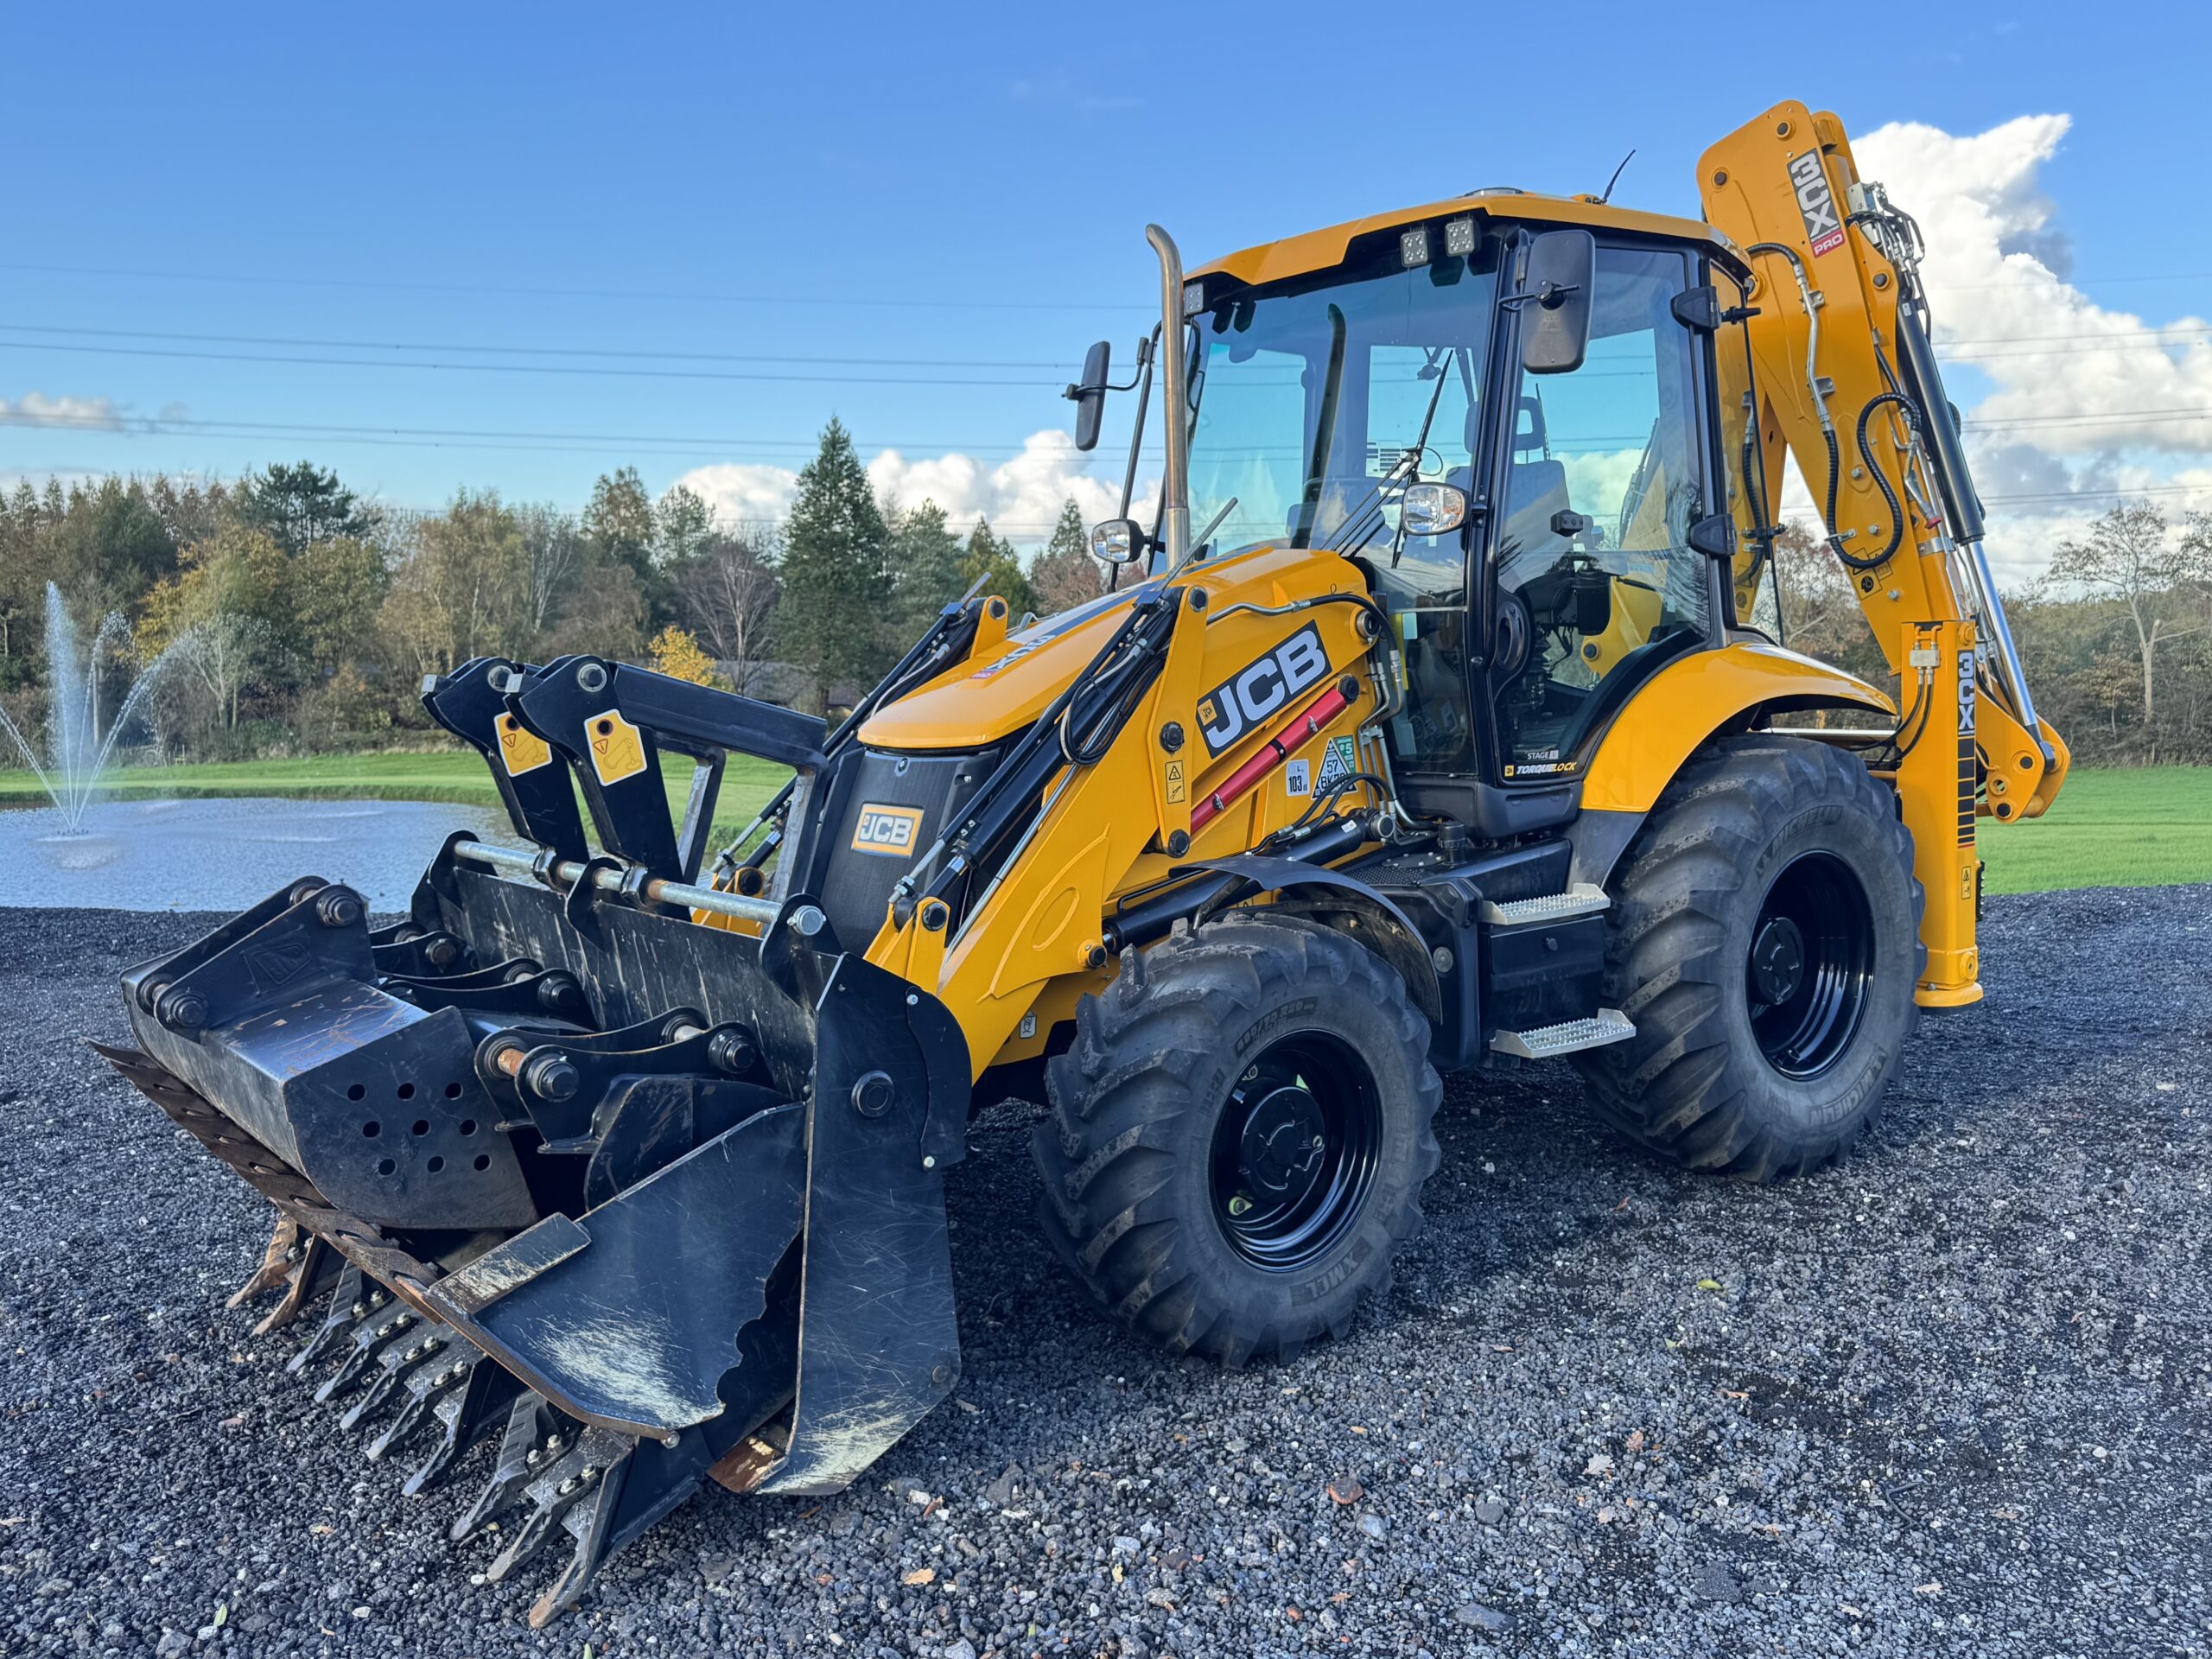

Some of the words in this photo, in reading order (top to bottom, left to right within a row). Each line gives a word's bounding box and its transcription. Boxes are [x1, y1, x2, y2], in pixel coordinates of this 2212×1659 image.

[1790, 153, 1838, 238] 3CX
[1814, 233, 1843, 255] PRO
[985, 634, 1056, 671] 3CX
[1206, 629, 1325, 748] JCB
[1958, 652, 1974, 729] 3CX
[1326, 760, 1338, 773] 57
[1516, 761, 1578, 775] TORQUELOCK
[1527, 751, 1548, 760] STAGE
[1288, 775, 1302, 792] 103
[859, 815, 913, 845] JCB
[1306, 1251, 1358, 1299] XMCL
